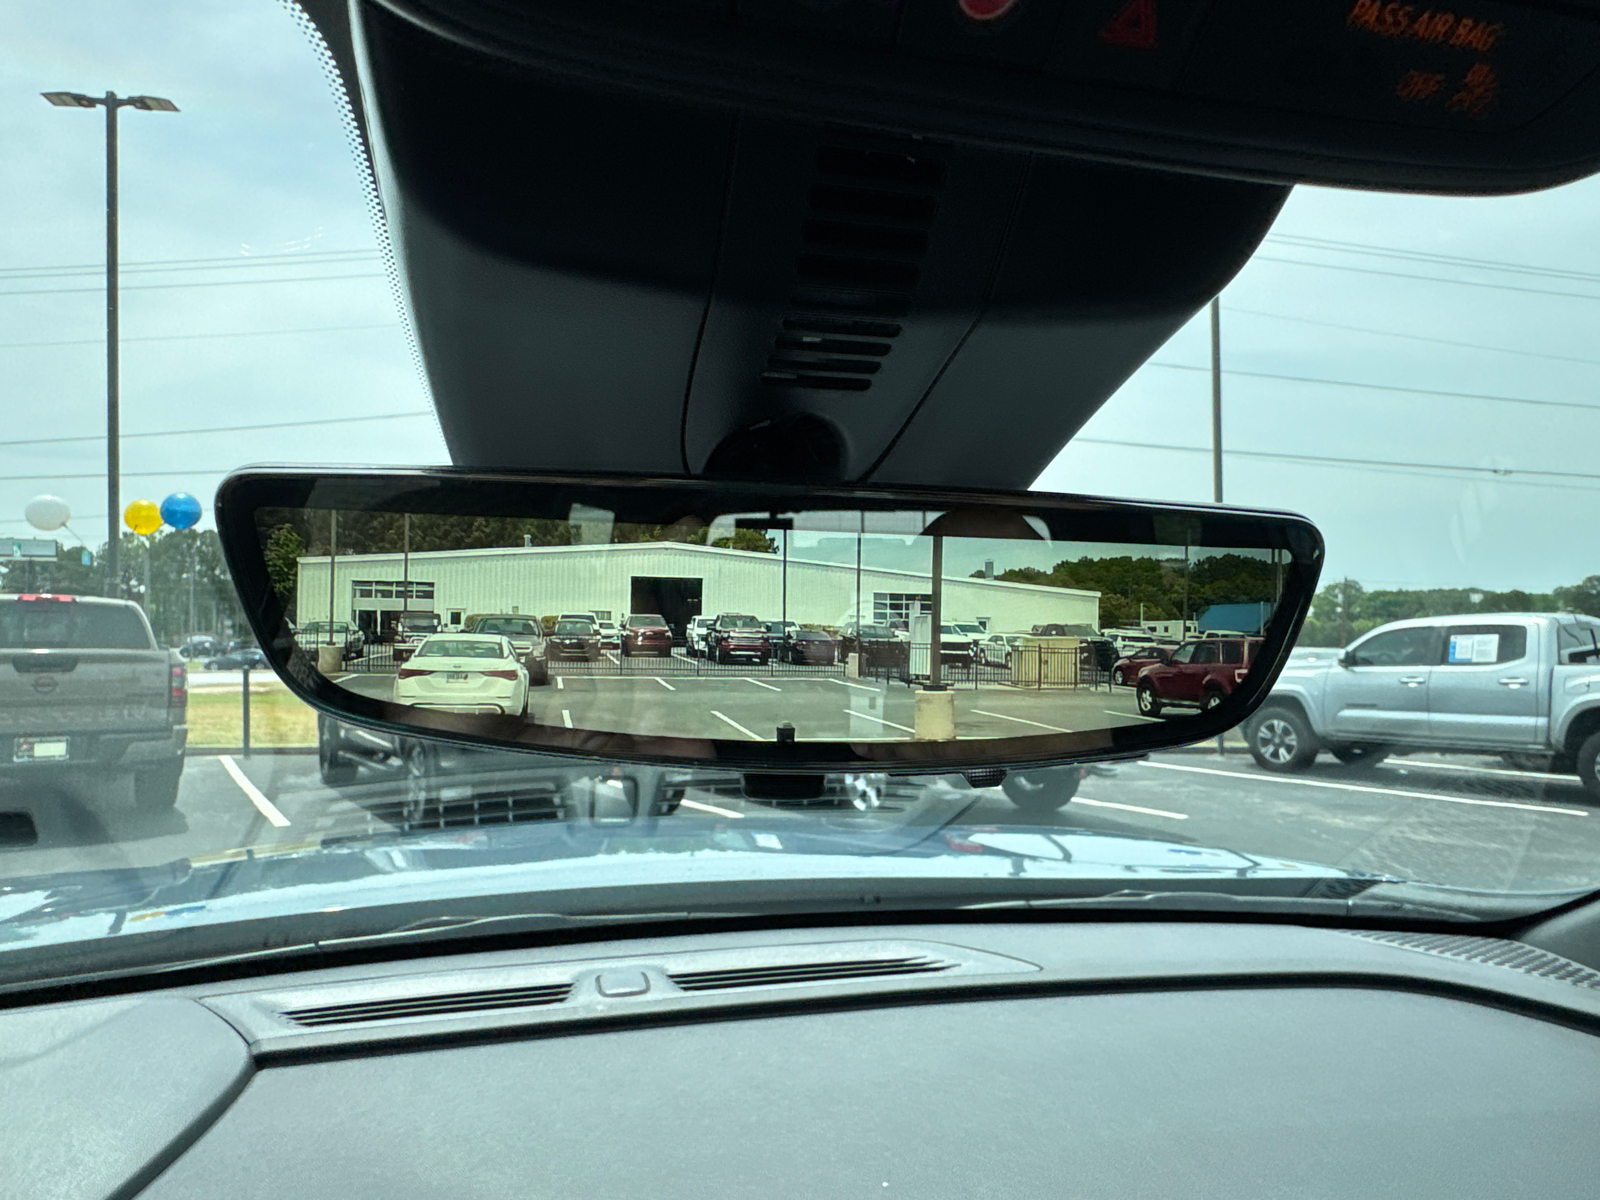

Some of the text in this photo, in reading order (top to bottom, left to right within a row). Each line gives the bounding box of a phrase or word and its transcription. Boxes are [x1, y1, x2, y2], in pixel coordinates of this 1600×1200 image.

[1347, 0, 1504, 51] PASS AIR BAG
